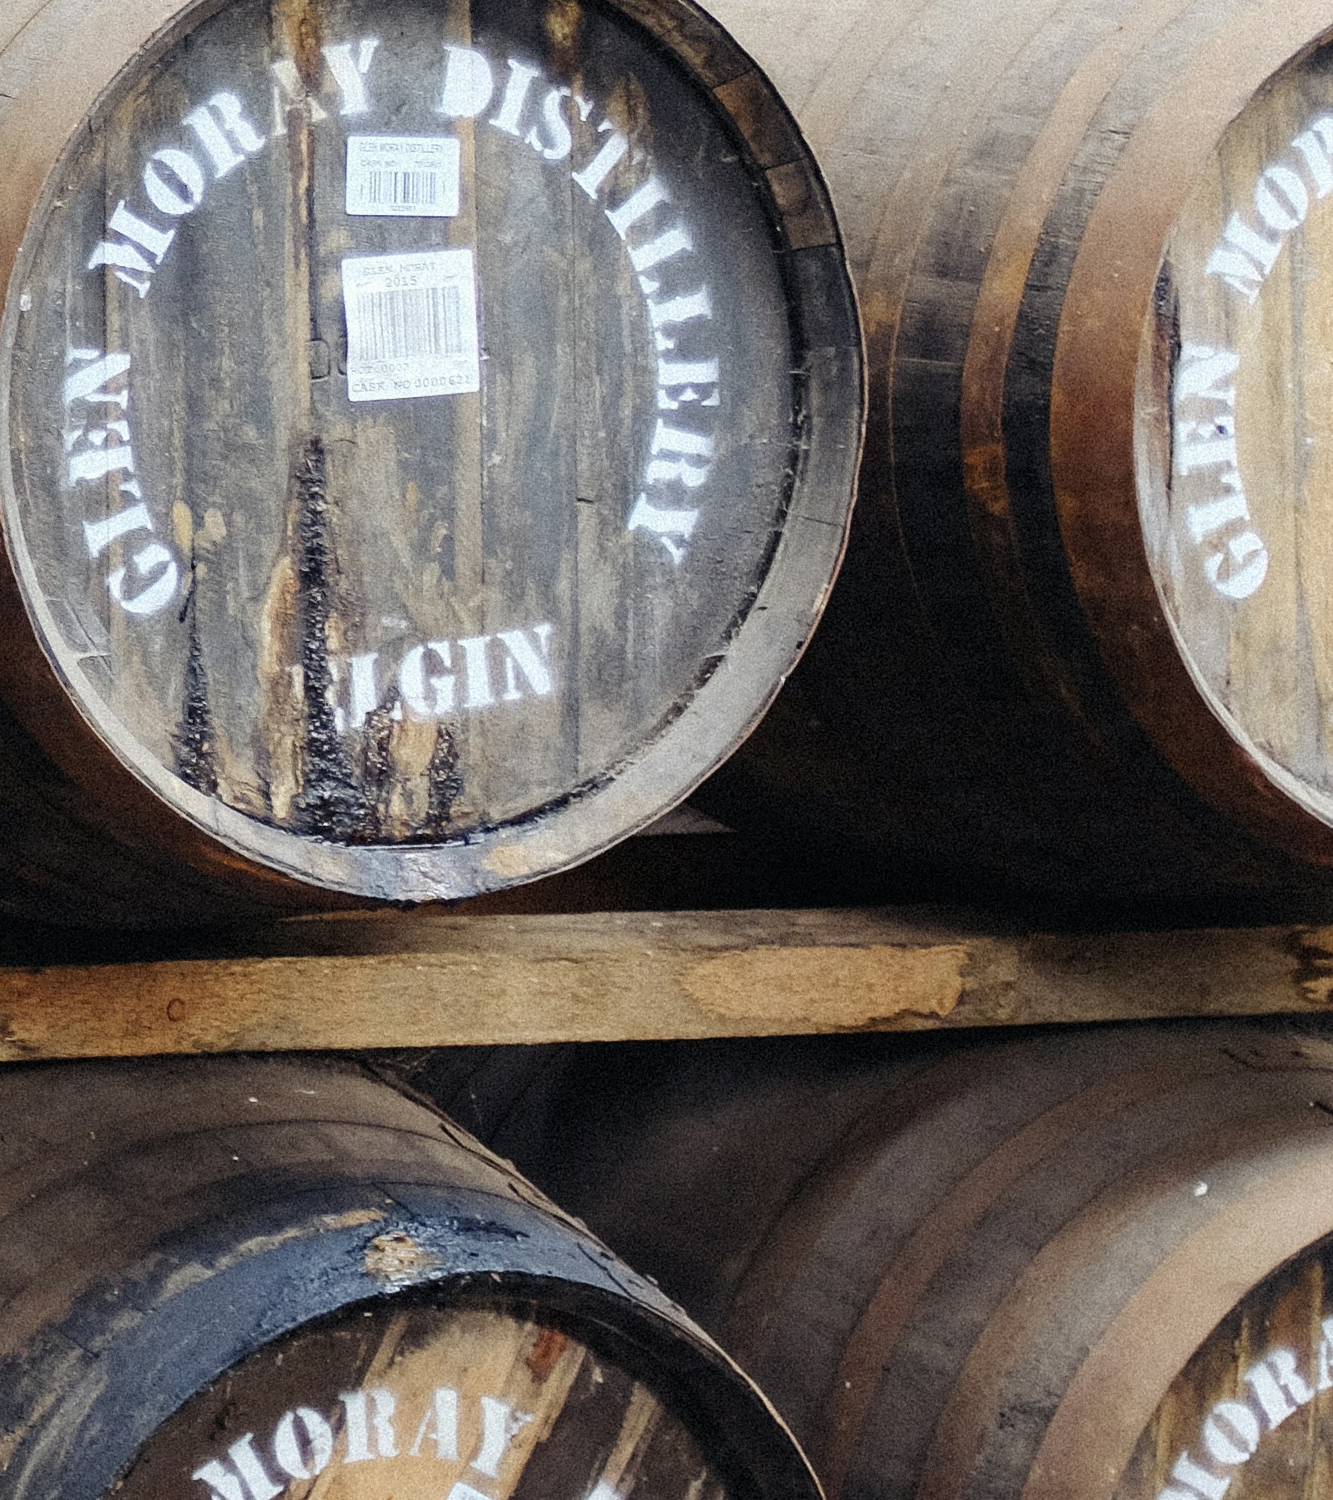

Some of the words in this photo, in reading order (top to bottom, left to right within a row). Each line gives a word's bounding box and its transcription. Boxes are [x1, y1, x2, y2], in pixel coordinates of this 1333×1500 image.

[88, 36, 381, 299] MORAY
[385, 275, 418, 288] 2015
[351, 382, 386, 393] CASK
[432, 42, 722, 567] DISTILLERY
[61, 347, 184, 617] GLEN
[1171, 345, 1269, 598] GLEN
